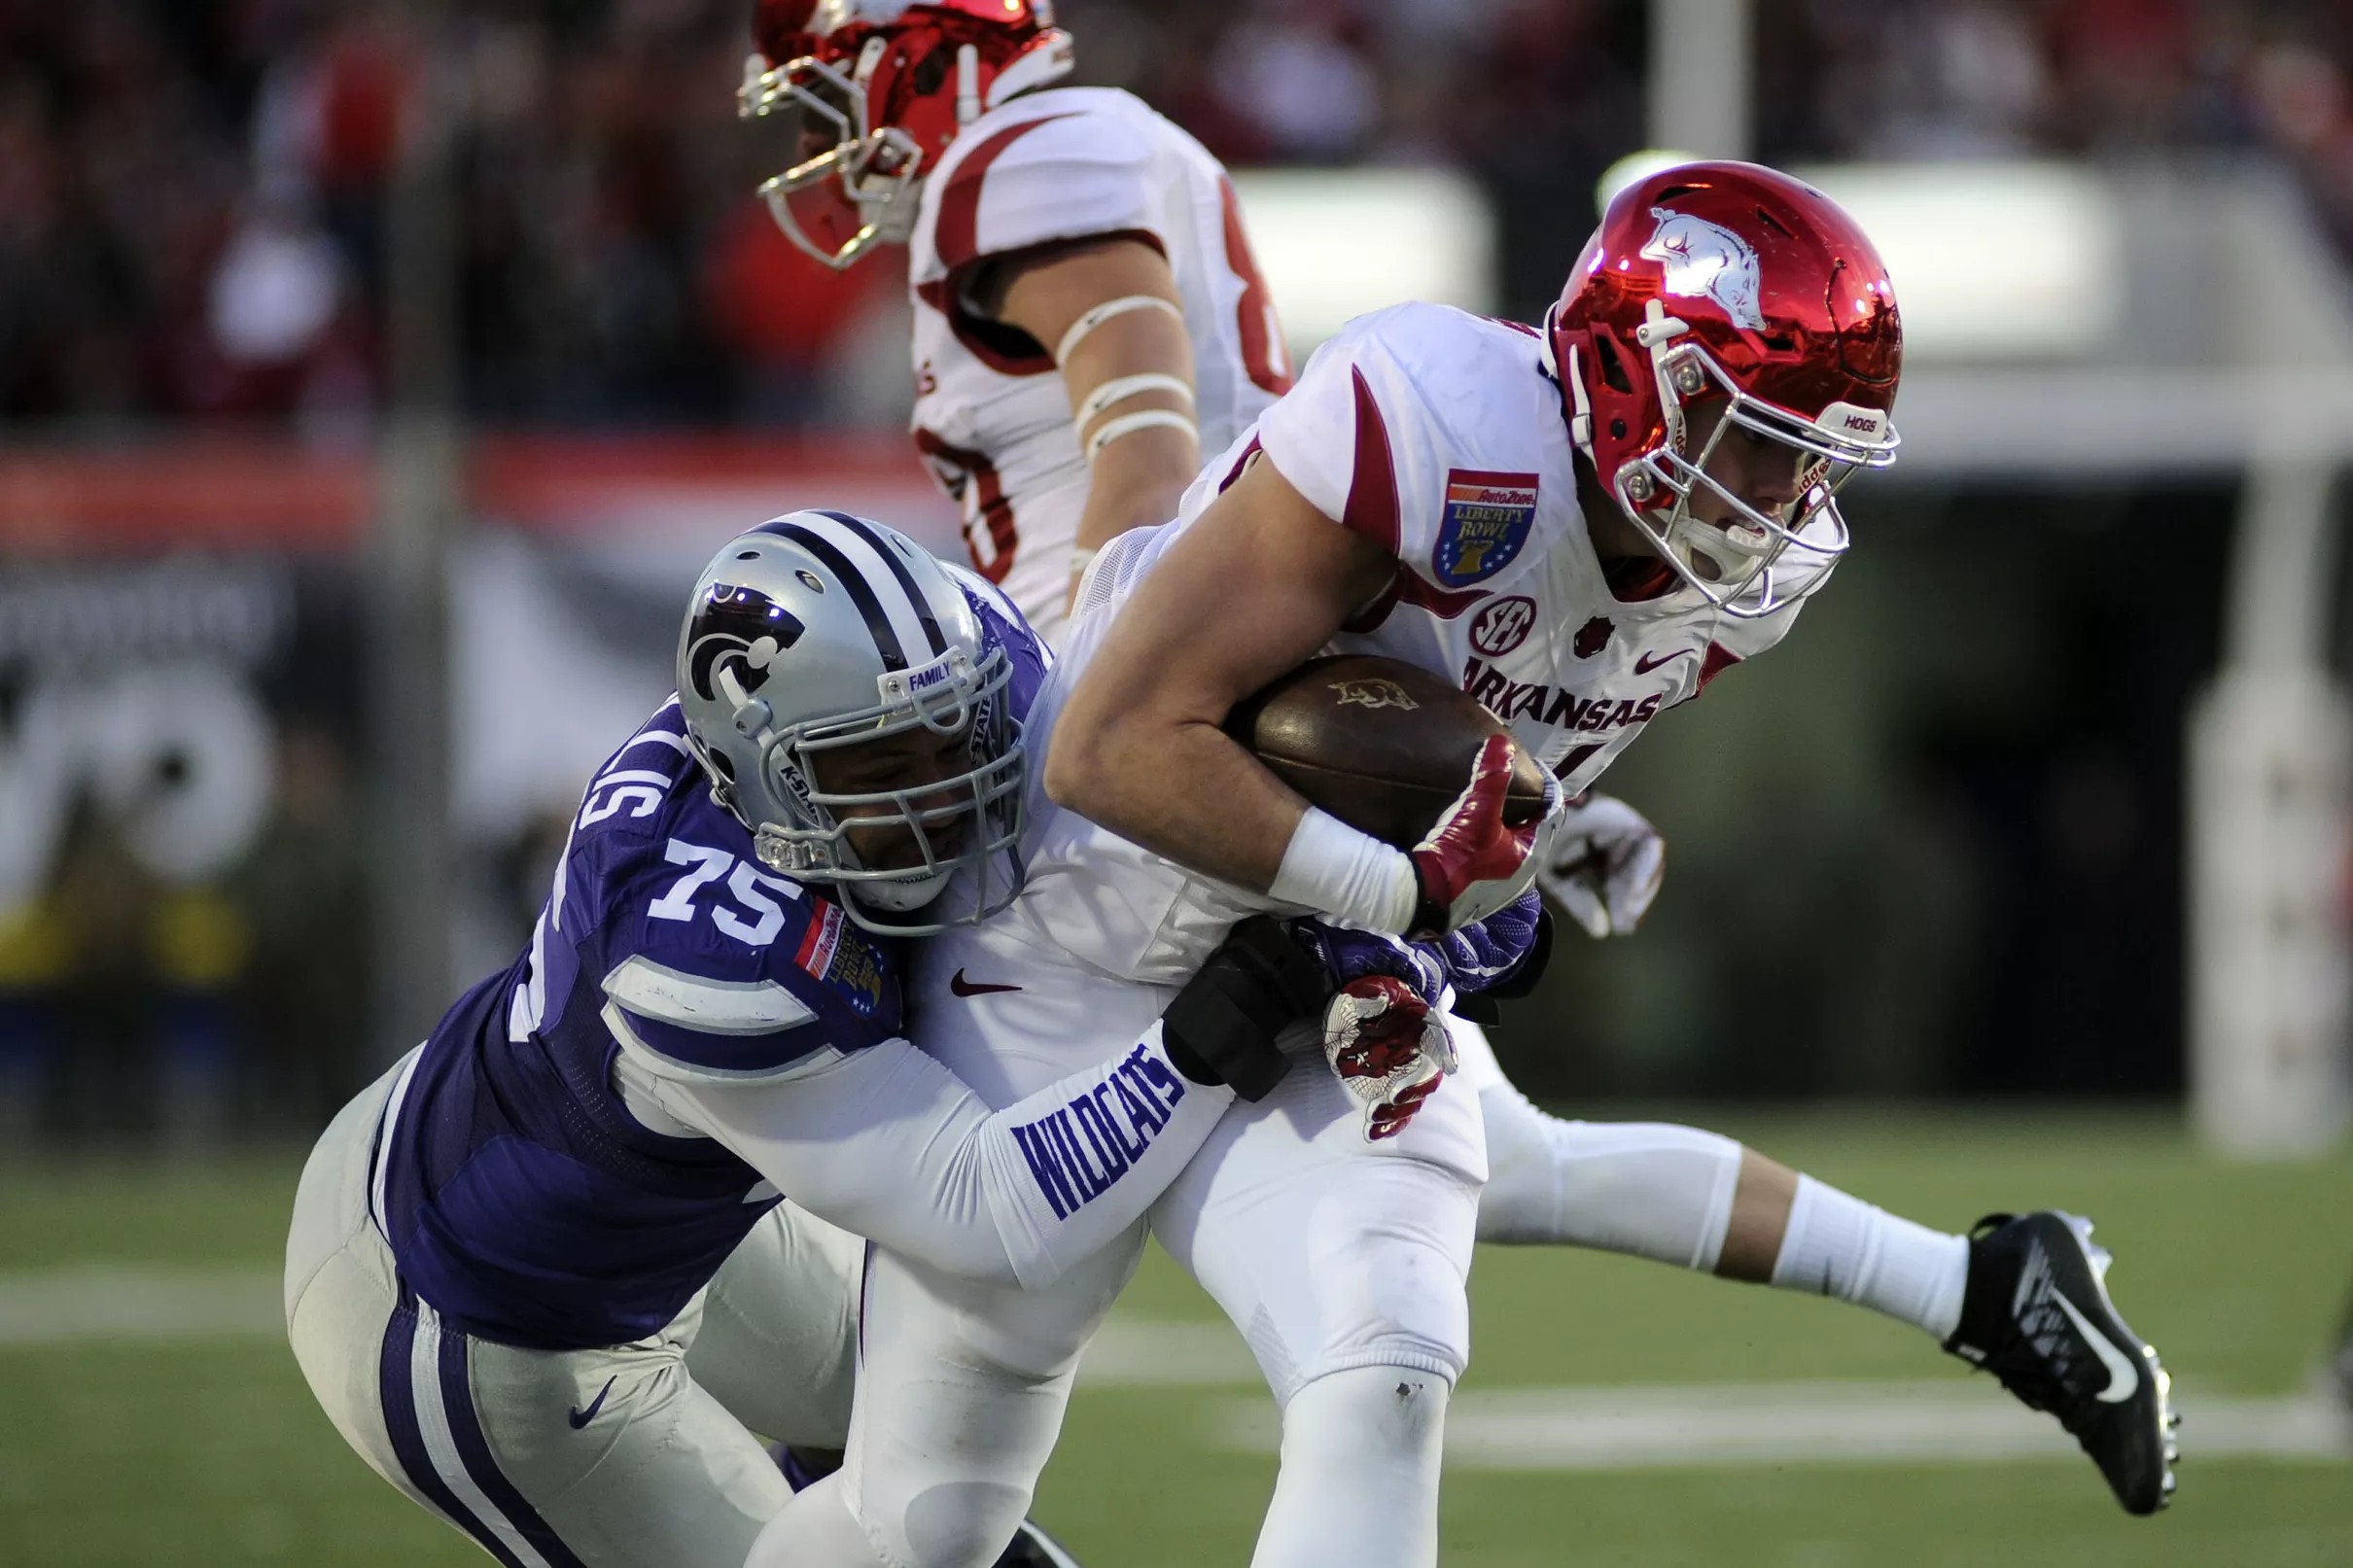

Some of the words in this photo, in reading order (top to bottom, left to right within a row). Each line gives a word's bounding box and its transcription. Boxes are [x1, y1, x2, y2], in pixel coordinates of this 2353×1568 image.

[1844, 414, 1878, 434] HOGS
[1454, 505, 1528, 524] LIBERTY
[1457, 520, 1511, 541] BOWL
[1475, 597, 1536, 654] SEC
[908, 660, 951, 692] FAMILY
[1463, 655, 1664, 732] ARKANSAS
[647, 837, 804, 947] 75
[1009, 1042, 1186, 1222] WILDCATS
